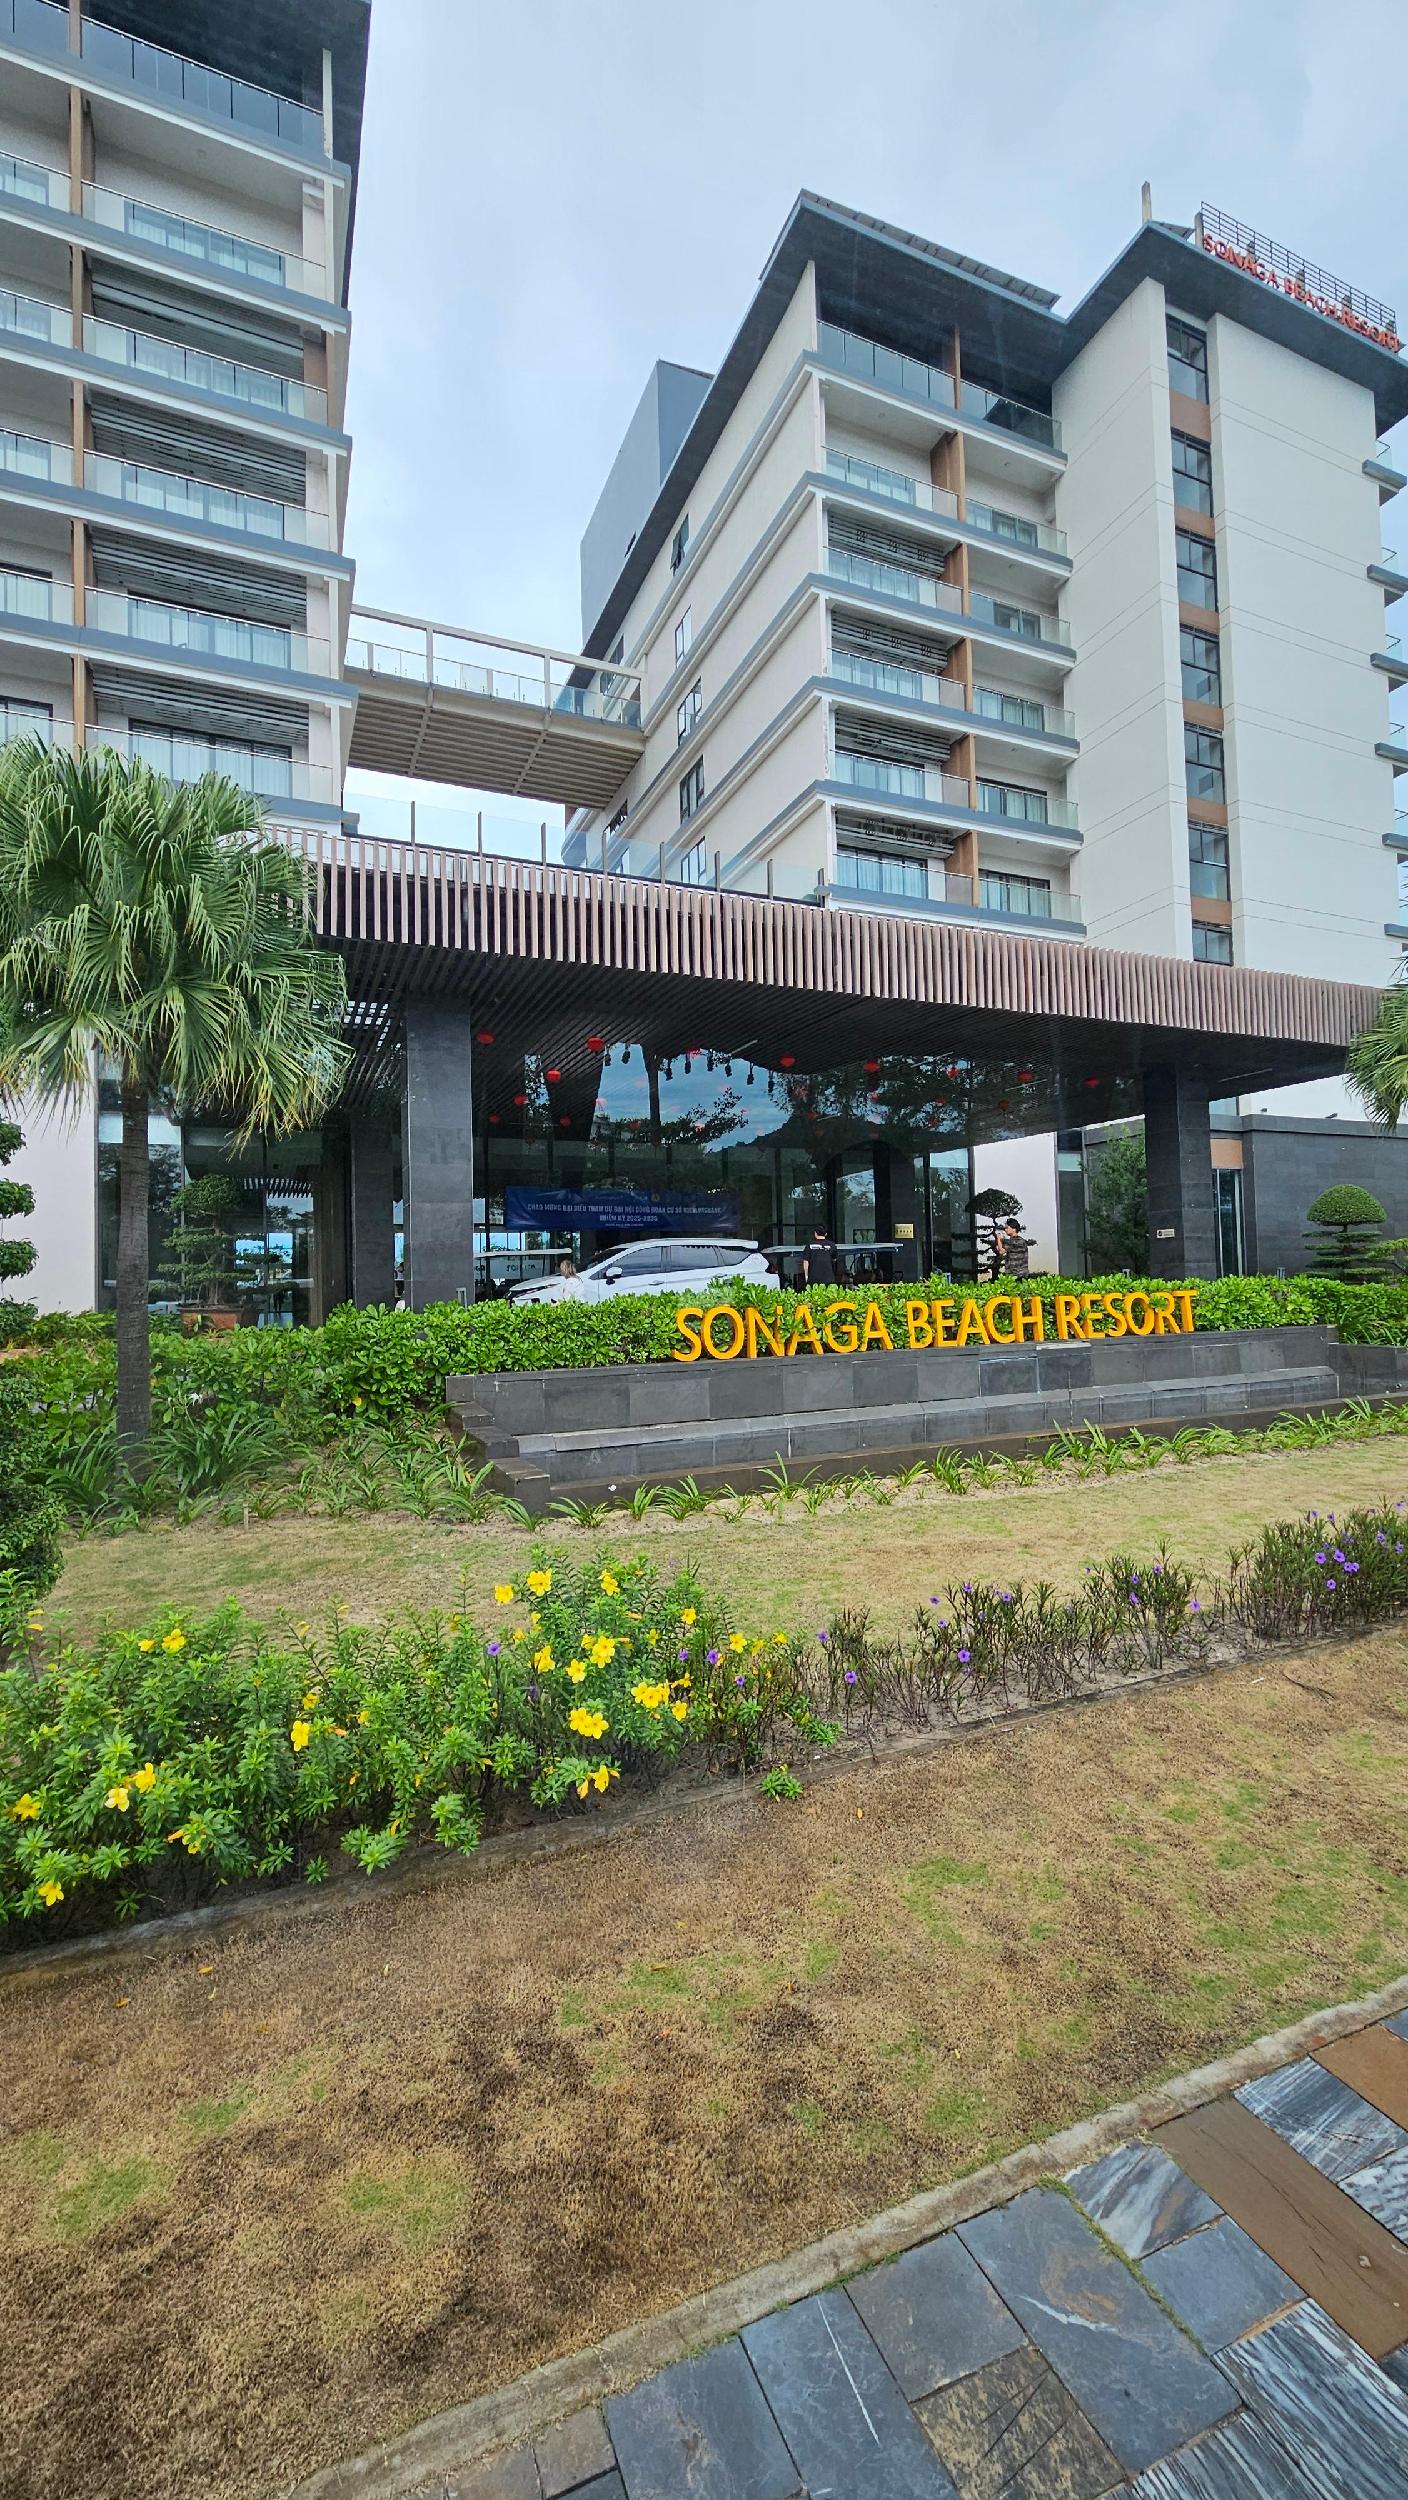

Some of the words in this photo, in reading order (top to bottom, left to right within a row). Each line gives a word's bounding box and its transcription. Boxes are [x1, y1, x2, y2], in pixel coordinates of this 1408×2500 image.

[1203, 234, 1279, 288] SONAGA
[1283, 276, 1338, 319] BEACH
[1341, 305, 1400, 353] RESORT
[671, 1301, 894, 1362] SONAGA
[905, 1295, 1044, 1349] BEACH
[1055, 1289, 1198, 1340] RESORT
